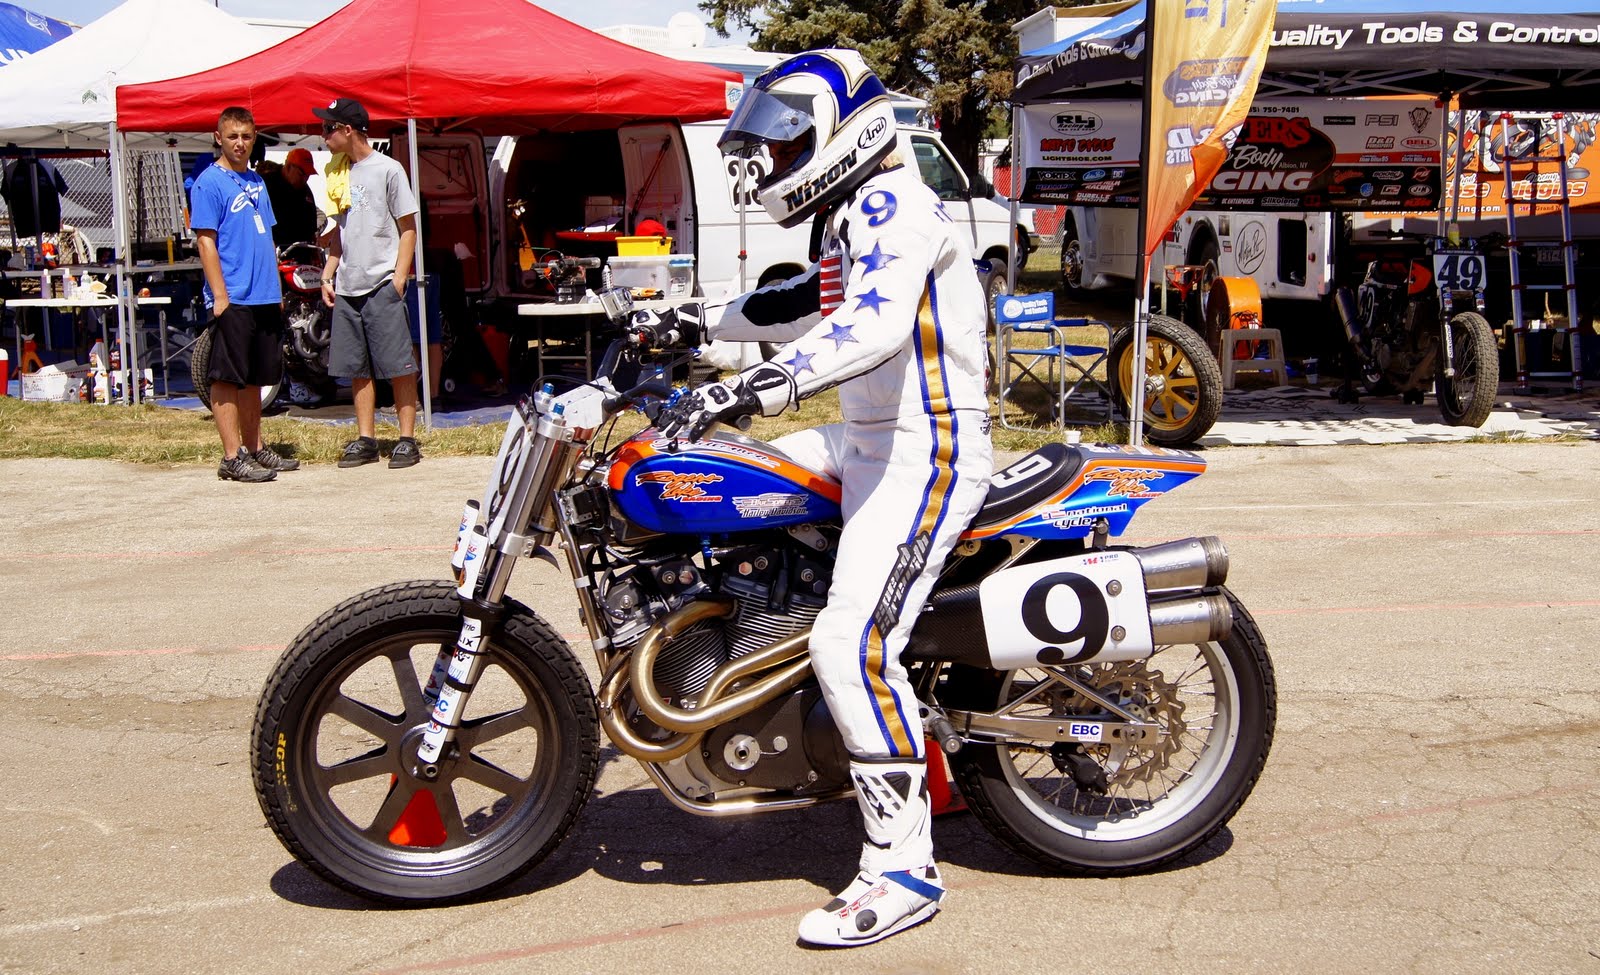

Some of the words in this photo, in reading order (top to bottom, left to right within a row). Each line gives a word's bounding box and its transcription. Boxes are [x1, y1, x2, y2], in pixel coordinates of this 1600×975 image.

[1271, 24, 1353, 49] uality
[1362, 22, 1443, 45] Tools
[1453, 21, 1478, 43] &
[1365, 114, 1399, 126] PSI
[864, 121, 886, 143] Arai
[1233, 145, 1283, 170] Body
[861, 190, 897, 227] 9
[1438, 256, 1482, 290] 49
[1067, 504, 1128, 517] national
[1054, 517, 1091, 529] cycle
[1021, 572, 1110, 665] 9
[1071, 724, 1100, 735] EBC
